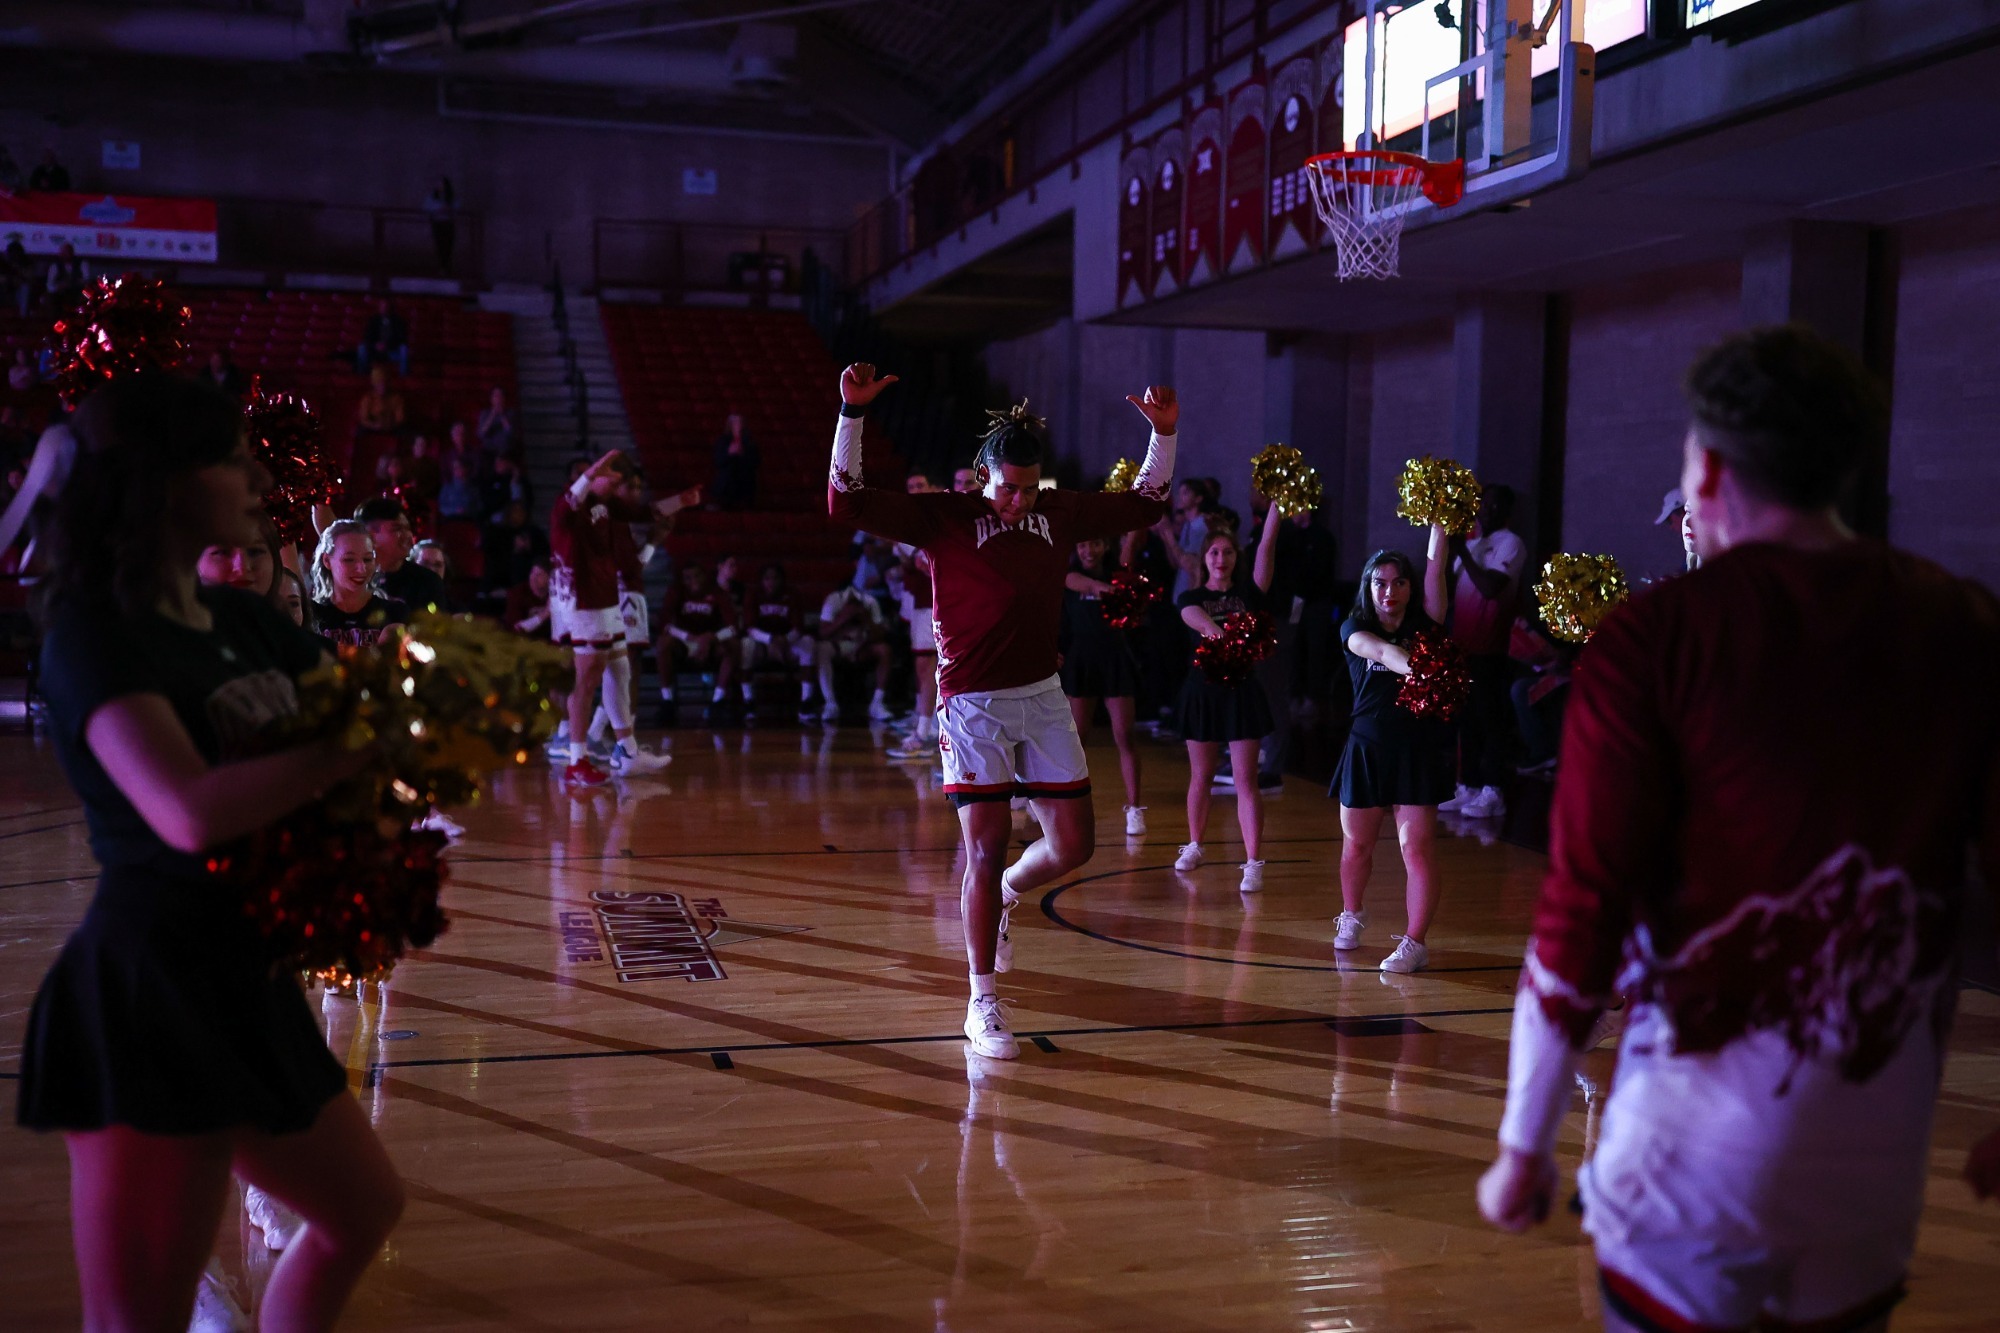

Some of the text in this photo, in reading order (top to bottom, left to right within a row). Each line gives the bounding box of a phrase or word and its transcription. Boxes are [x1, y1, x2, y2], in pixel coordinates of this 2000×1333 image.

[974, 513, 1053, 549] DEER
[691, 898, 728, 918] THE
[559, 912, 603, 962] LEAGUE
[588, 891, 728, 983] SUMMIT
